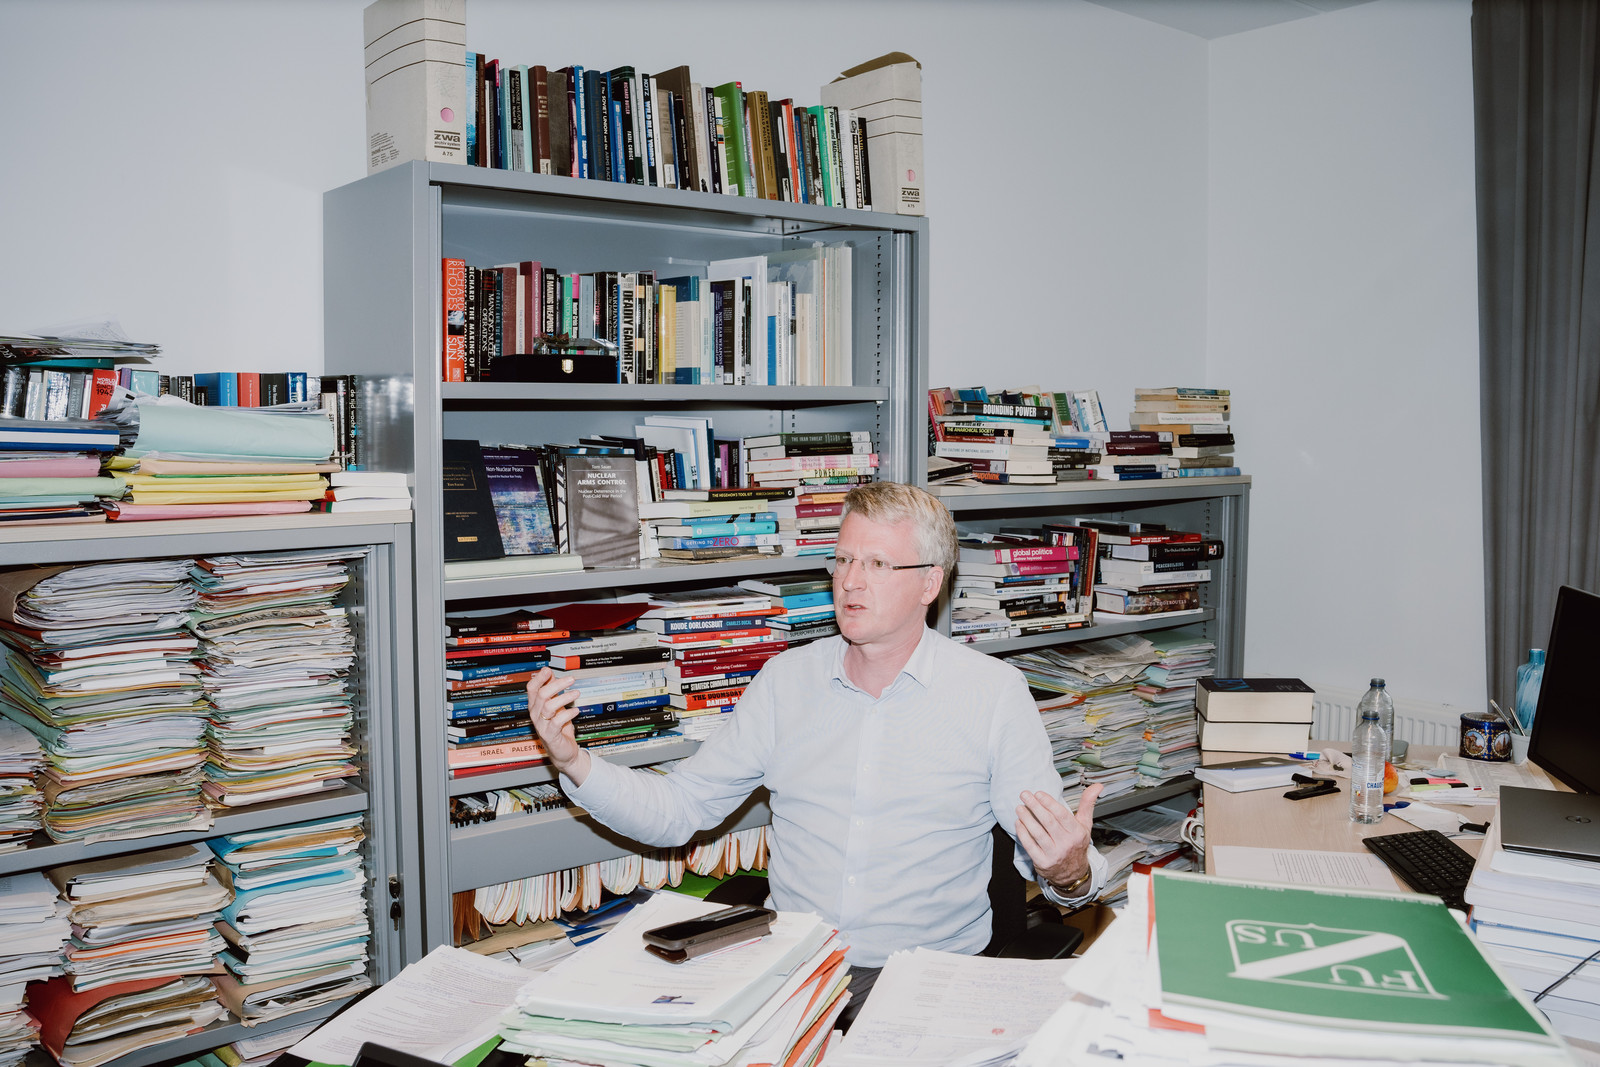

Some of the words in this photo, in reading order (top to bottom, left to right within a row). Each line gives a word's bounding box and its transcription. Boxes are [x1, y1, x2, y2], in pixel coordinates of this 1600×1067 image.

[644, 101, 652, 120] WILD
[645, 119, 653, 139] BLUE
[434, 134, 461, 143] zwa
[647, 138, 656, 167] YONDER
[853, 144, 861, 181] KENNEDY
[448, 260, 458, 310] RHODES
[457, 260, 465, 311] RICHARD
[546, 281, 554, 304] MAKING
[622, 290, 634, 327] DEADLY
[546, 305, 554, 333] WEAPONS
[448, 337, 457, 360] SUN
[457, 336, 465, 361] DARK
[623, 327, 634, 373] GAMBITS
[469, 357, 475, 368] OF
[350, 389, 356, 398] de
[348, 398, 356, 409] tijd
[982, 404, 1014, 416] BOUNDING
[1015, 406, 1037, 417] POWER
[349, 429, 356, 438] op
[814, 468, 836, 478] POWER
[713, 537, 740, 547] ZERO
[1012, 548, 1031, 558] global
[1031, 547, 1053, 557] politics
[671, 621, 688, 631] KOUDE
[688, 620, 724, 630] OORLOGSBUIT
[790, 629, 816, 638] SUPERPOWER
[690, 682, 710, 692] STRATEGIC
[710, 679, 729, 689] COMMAND
[692, 694, 707, 702] THE
[708, 690, 742, 699] DOOMSDAY
[706, 698, 731, 707] DANIEL
[1234, 924, 1317, 950] US
